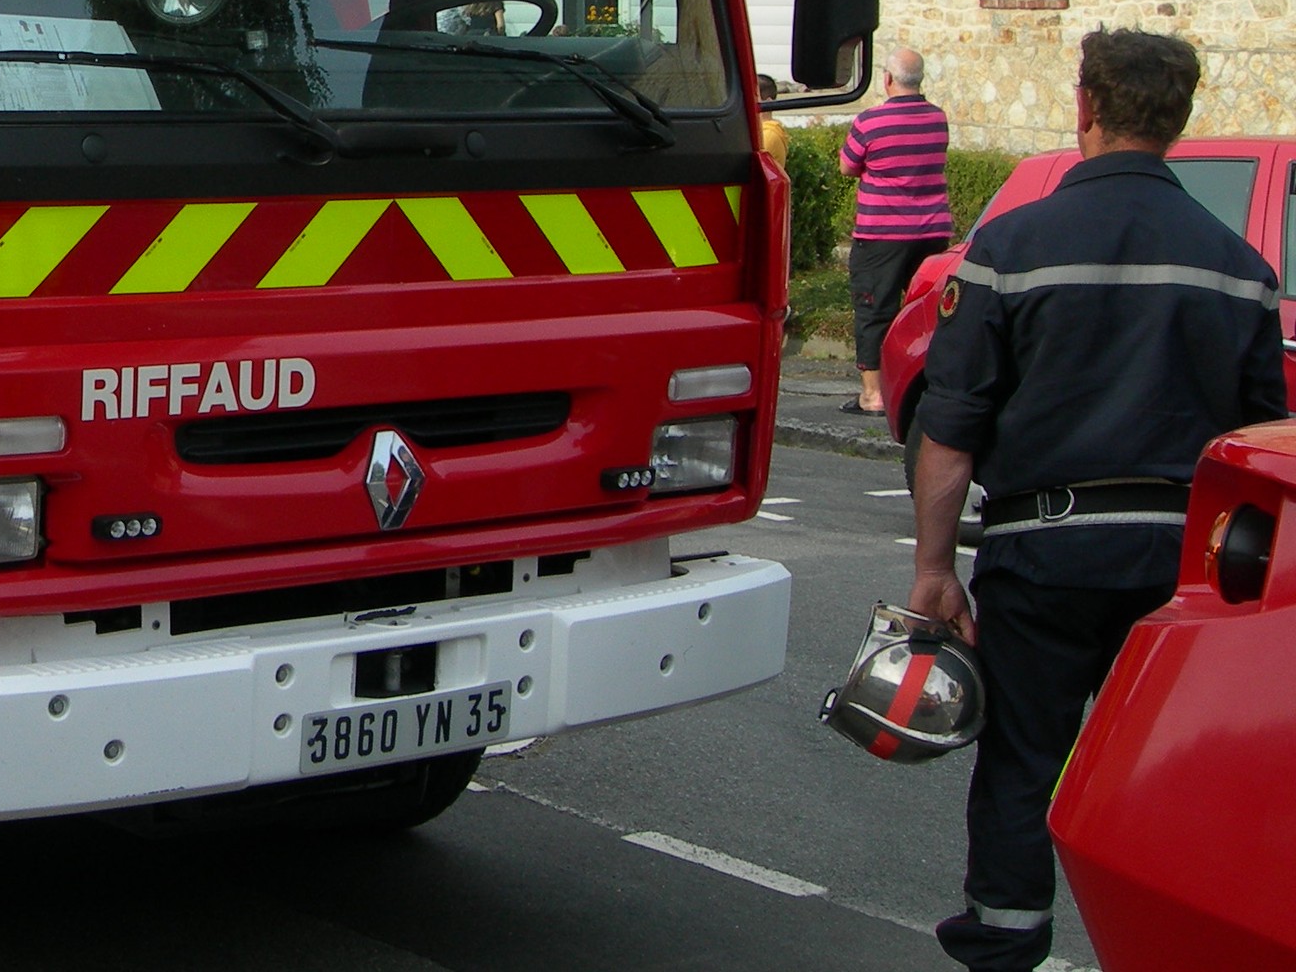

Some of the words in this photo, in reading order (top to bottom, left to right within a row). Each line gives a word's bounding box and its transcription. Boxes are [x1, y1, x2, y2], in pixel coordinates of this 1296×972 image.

[81, 357, 316, 422] RIFFAUD
[307, 709, 398, 764] 3860
[416, 700, 452, 747] YN
[466, 689, 505, 737] 35
